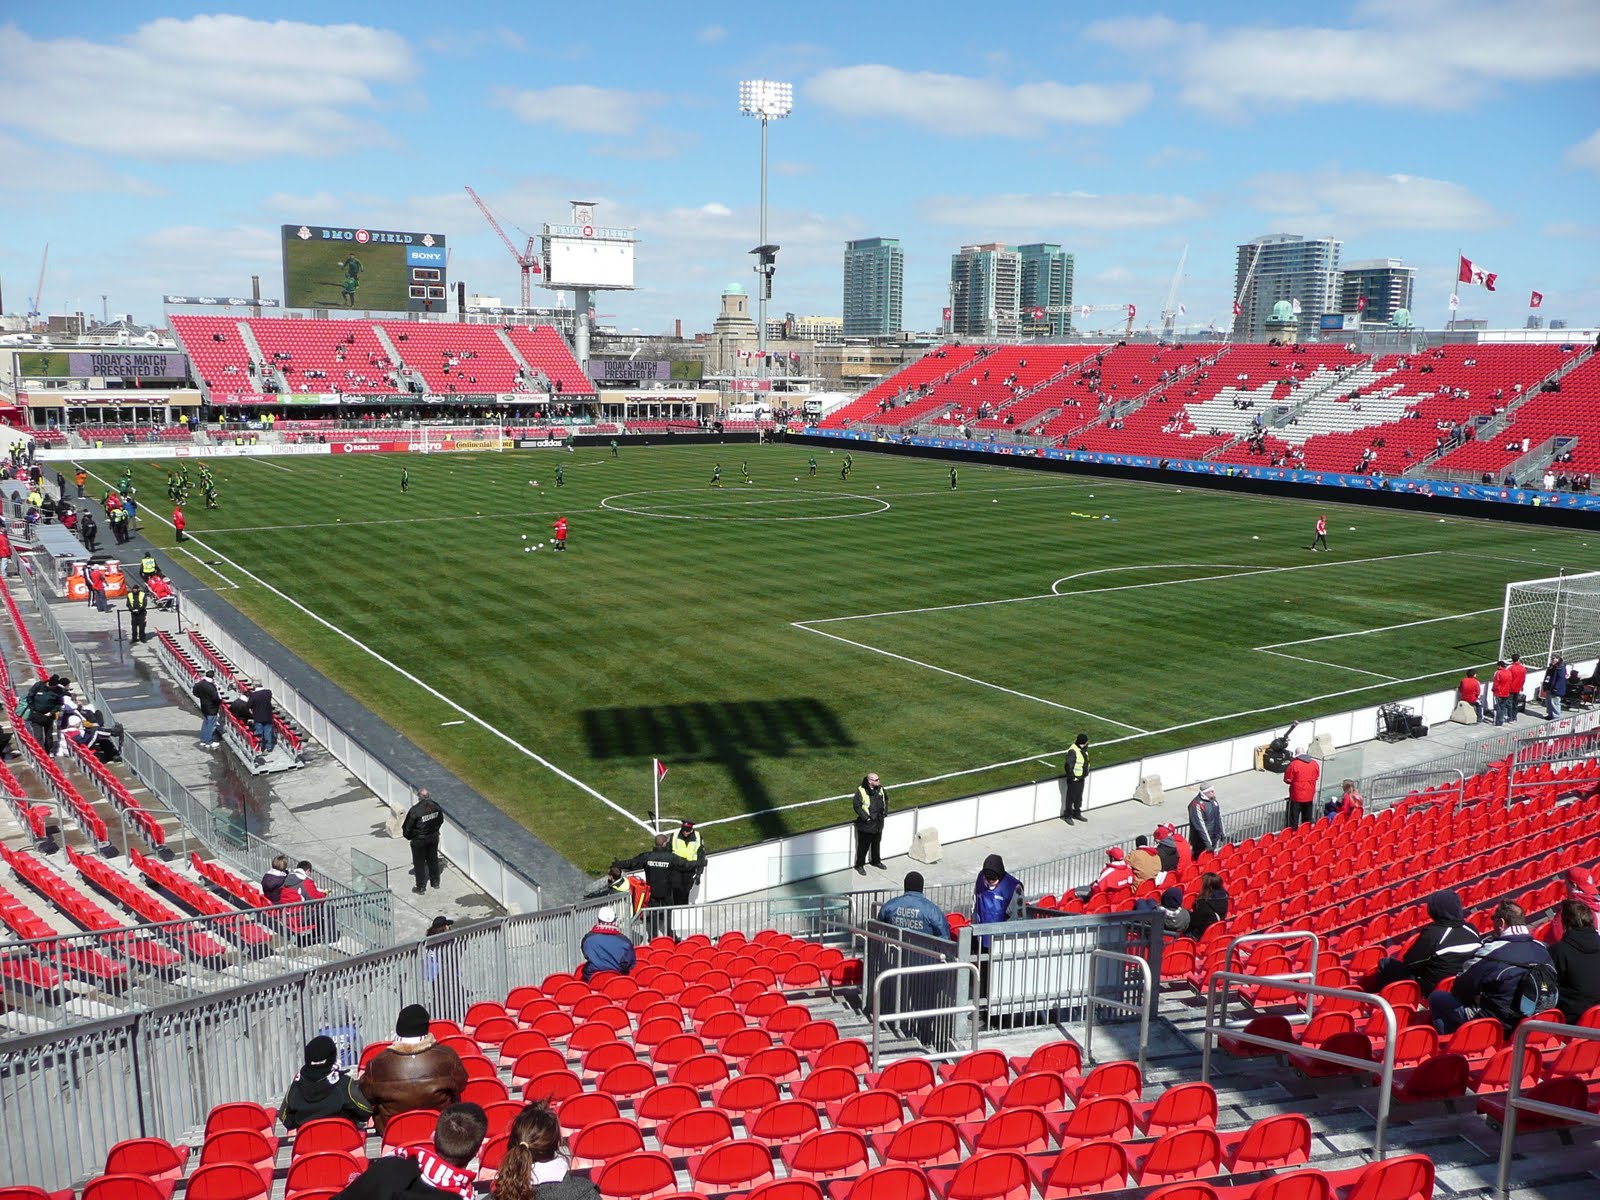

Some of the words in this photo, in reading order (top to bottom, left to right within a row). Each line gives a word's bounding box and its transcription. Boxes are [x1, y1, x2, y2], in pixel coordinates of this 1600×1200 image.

[322, 229, 353, 240] BMO
[372, 232, 413, 244] FIELD
[411, 252, 441, 260] SONY
[90, 354, 131, 366] TODAY'S
[134, 355, 167, 366] MATCH
[93, 365, 151, 376] PRESENTED
[153, 366, 167, 376] BY
[604, 361, 633, 370] TODAY'S
[634, 361, 658, 370] MATCH
[604, 370, 646, 379] PRESENTED
[647, 370, 657, 379] BY
[408, 442, 442, 451] metro
[456, 440, 492, 448] Continental
[896, 906, 920, 919] GUEST
[891, 916, 924, 930] SERVICES
